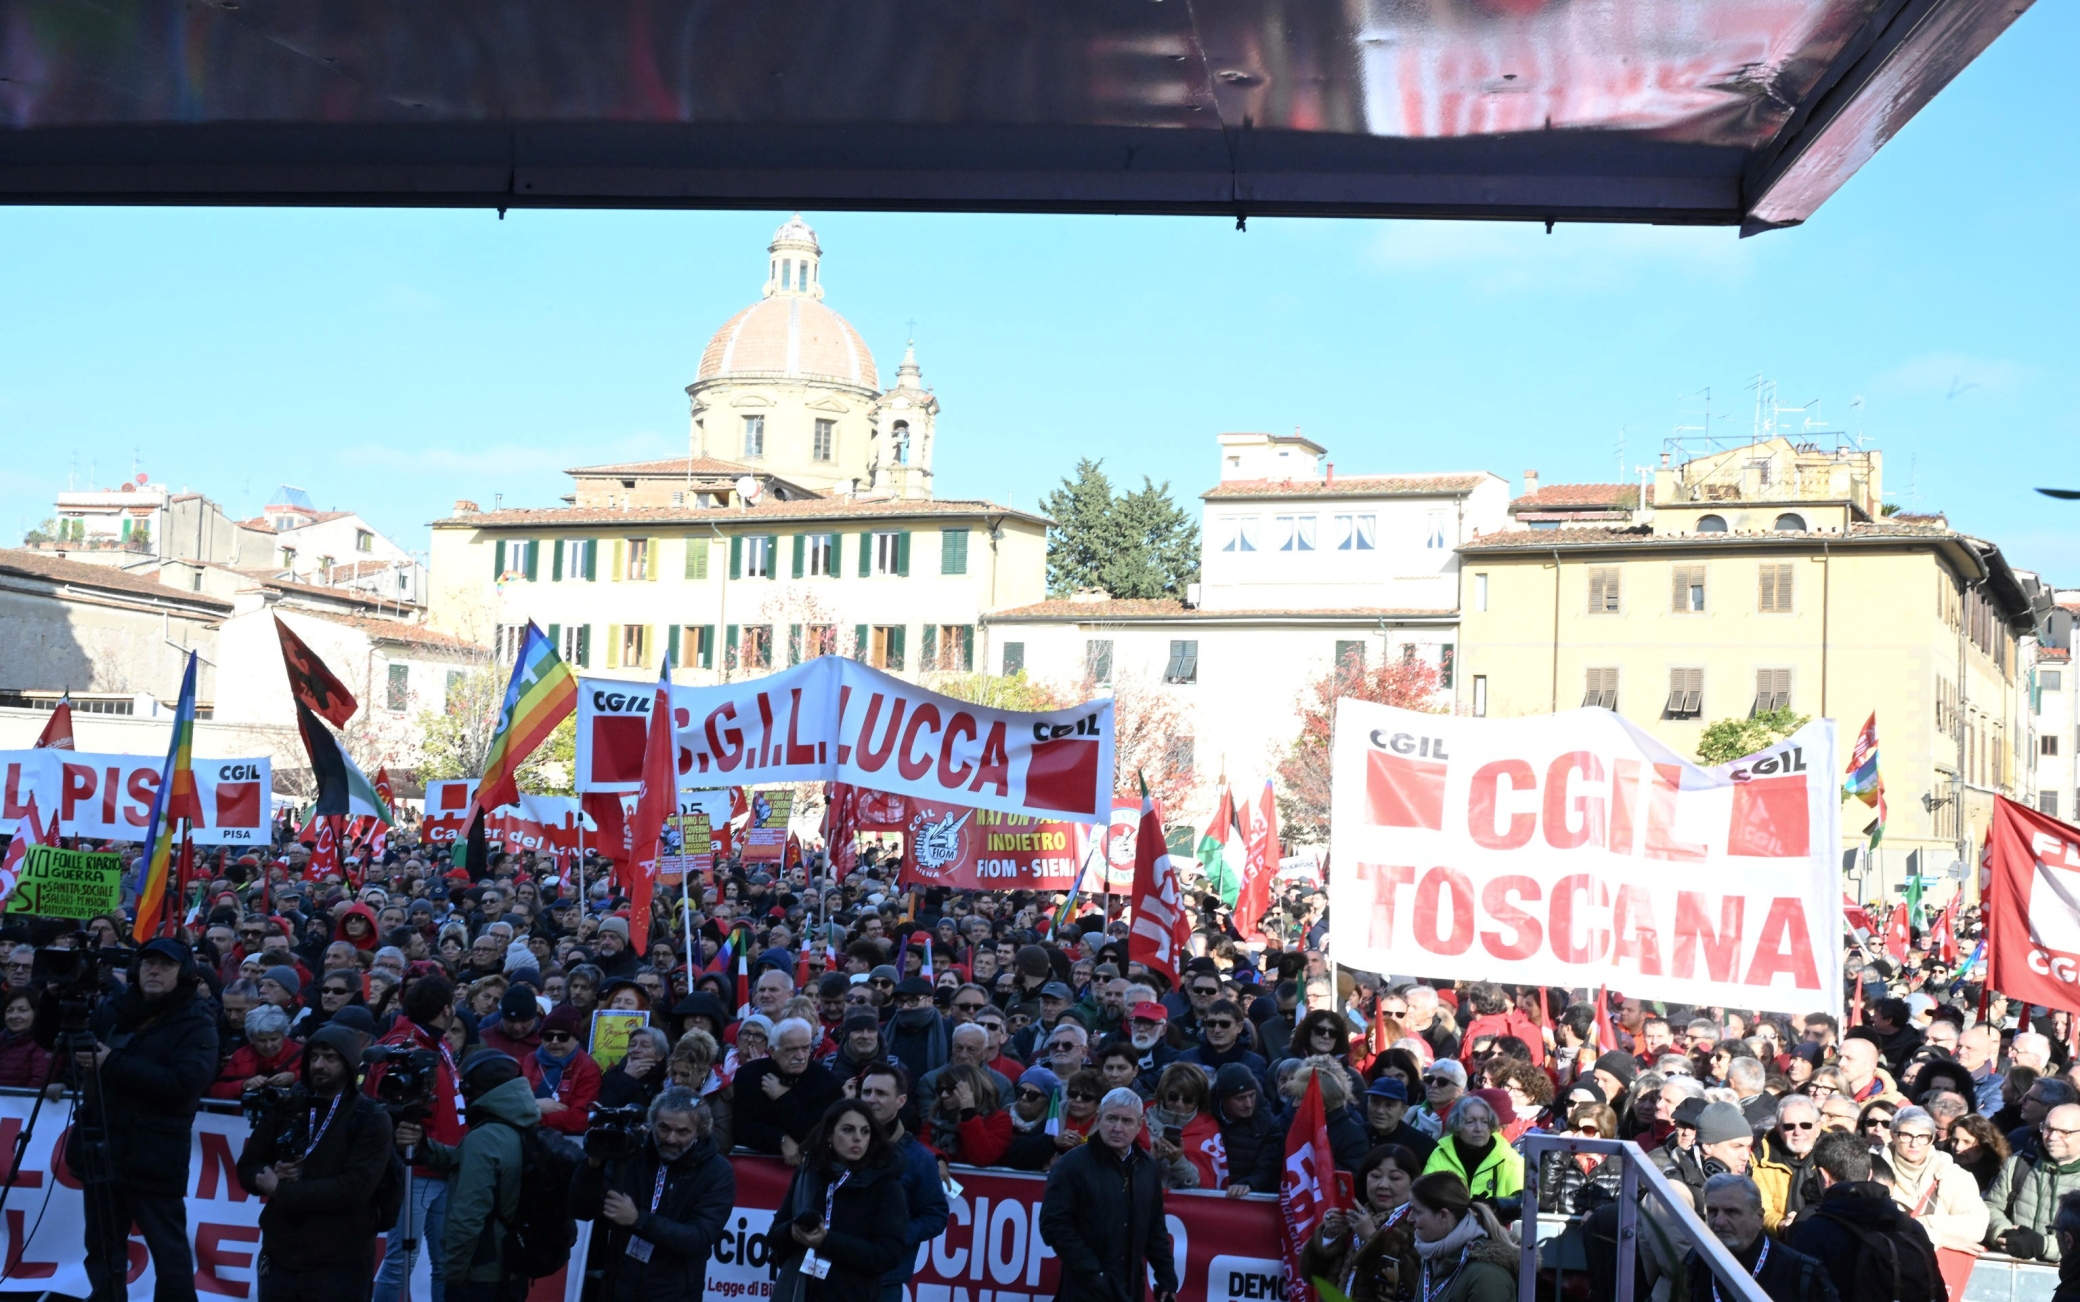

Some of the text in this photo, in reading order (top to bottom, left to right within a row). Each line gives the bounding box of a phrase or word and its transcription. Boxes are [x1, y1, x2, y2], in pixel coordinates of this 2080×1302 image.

[593, 691, 650, 713] CGIL
[676, 688, 828, 777] .G.I.L.
[1033, 713, 1100, 742] CGIL
[1369, 728, 1449, 760] CGIL
[219, 764, 260, 781] CGIL
[1729, 747, 1807, 782] CGIL
[1467, 751, 1708, 864] CGIL
[908, 808, 936, 832] CGIL
[223, 829, 251, 839] PISA
[510, 831, 544, 849] del
[988, 831, 1066, 851] INDIETRO
[20, 847, 51, 878] NO
[53, 852, 84, 870] FOLLE
[932, 848, 955, 859] FIOM
[51, 868, 105, 882] GUERRA
[914, 865, 940, 878] SIENA
[976, 858, 1017, 877] FIOM
[1356, 861, 1822, 990] TOSCANA
[708, 1277, 745, 1298] Legge
[747, 1281, 759, 1297] di
